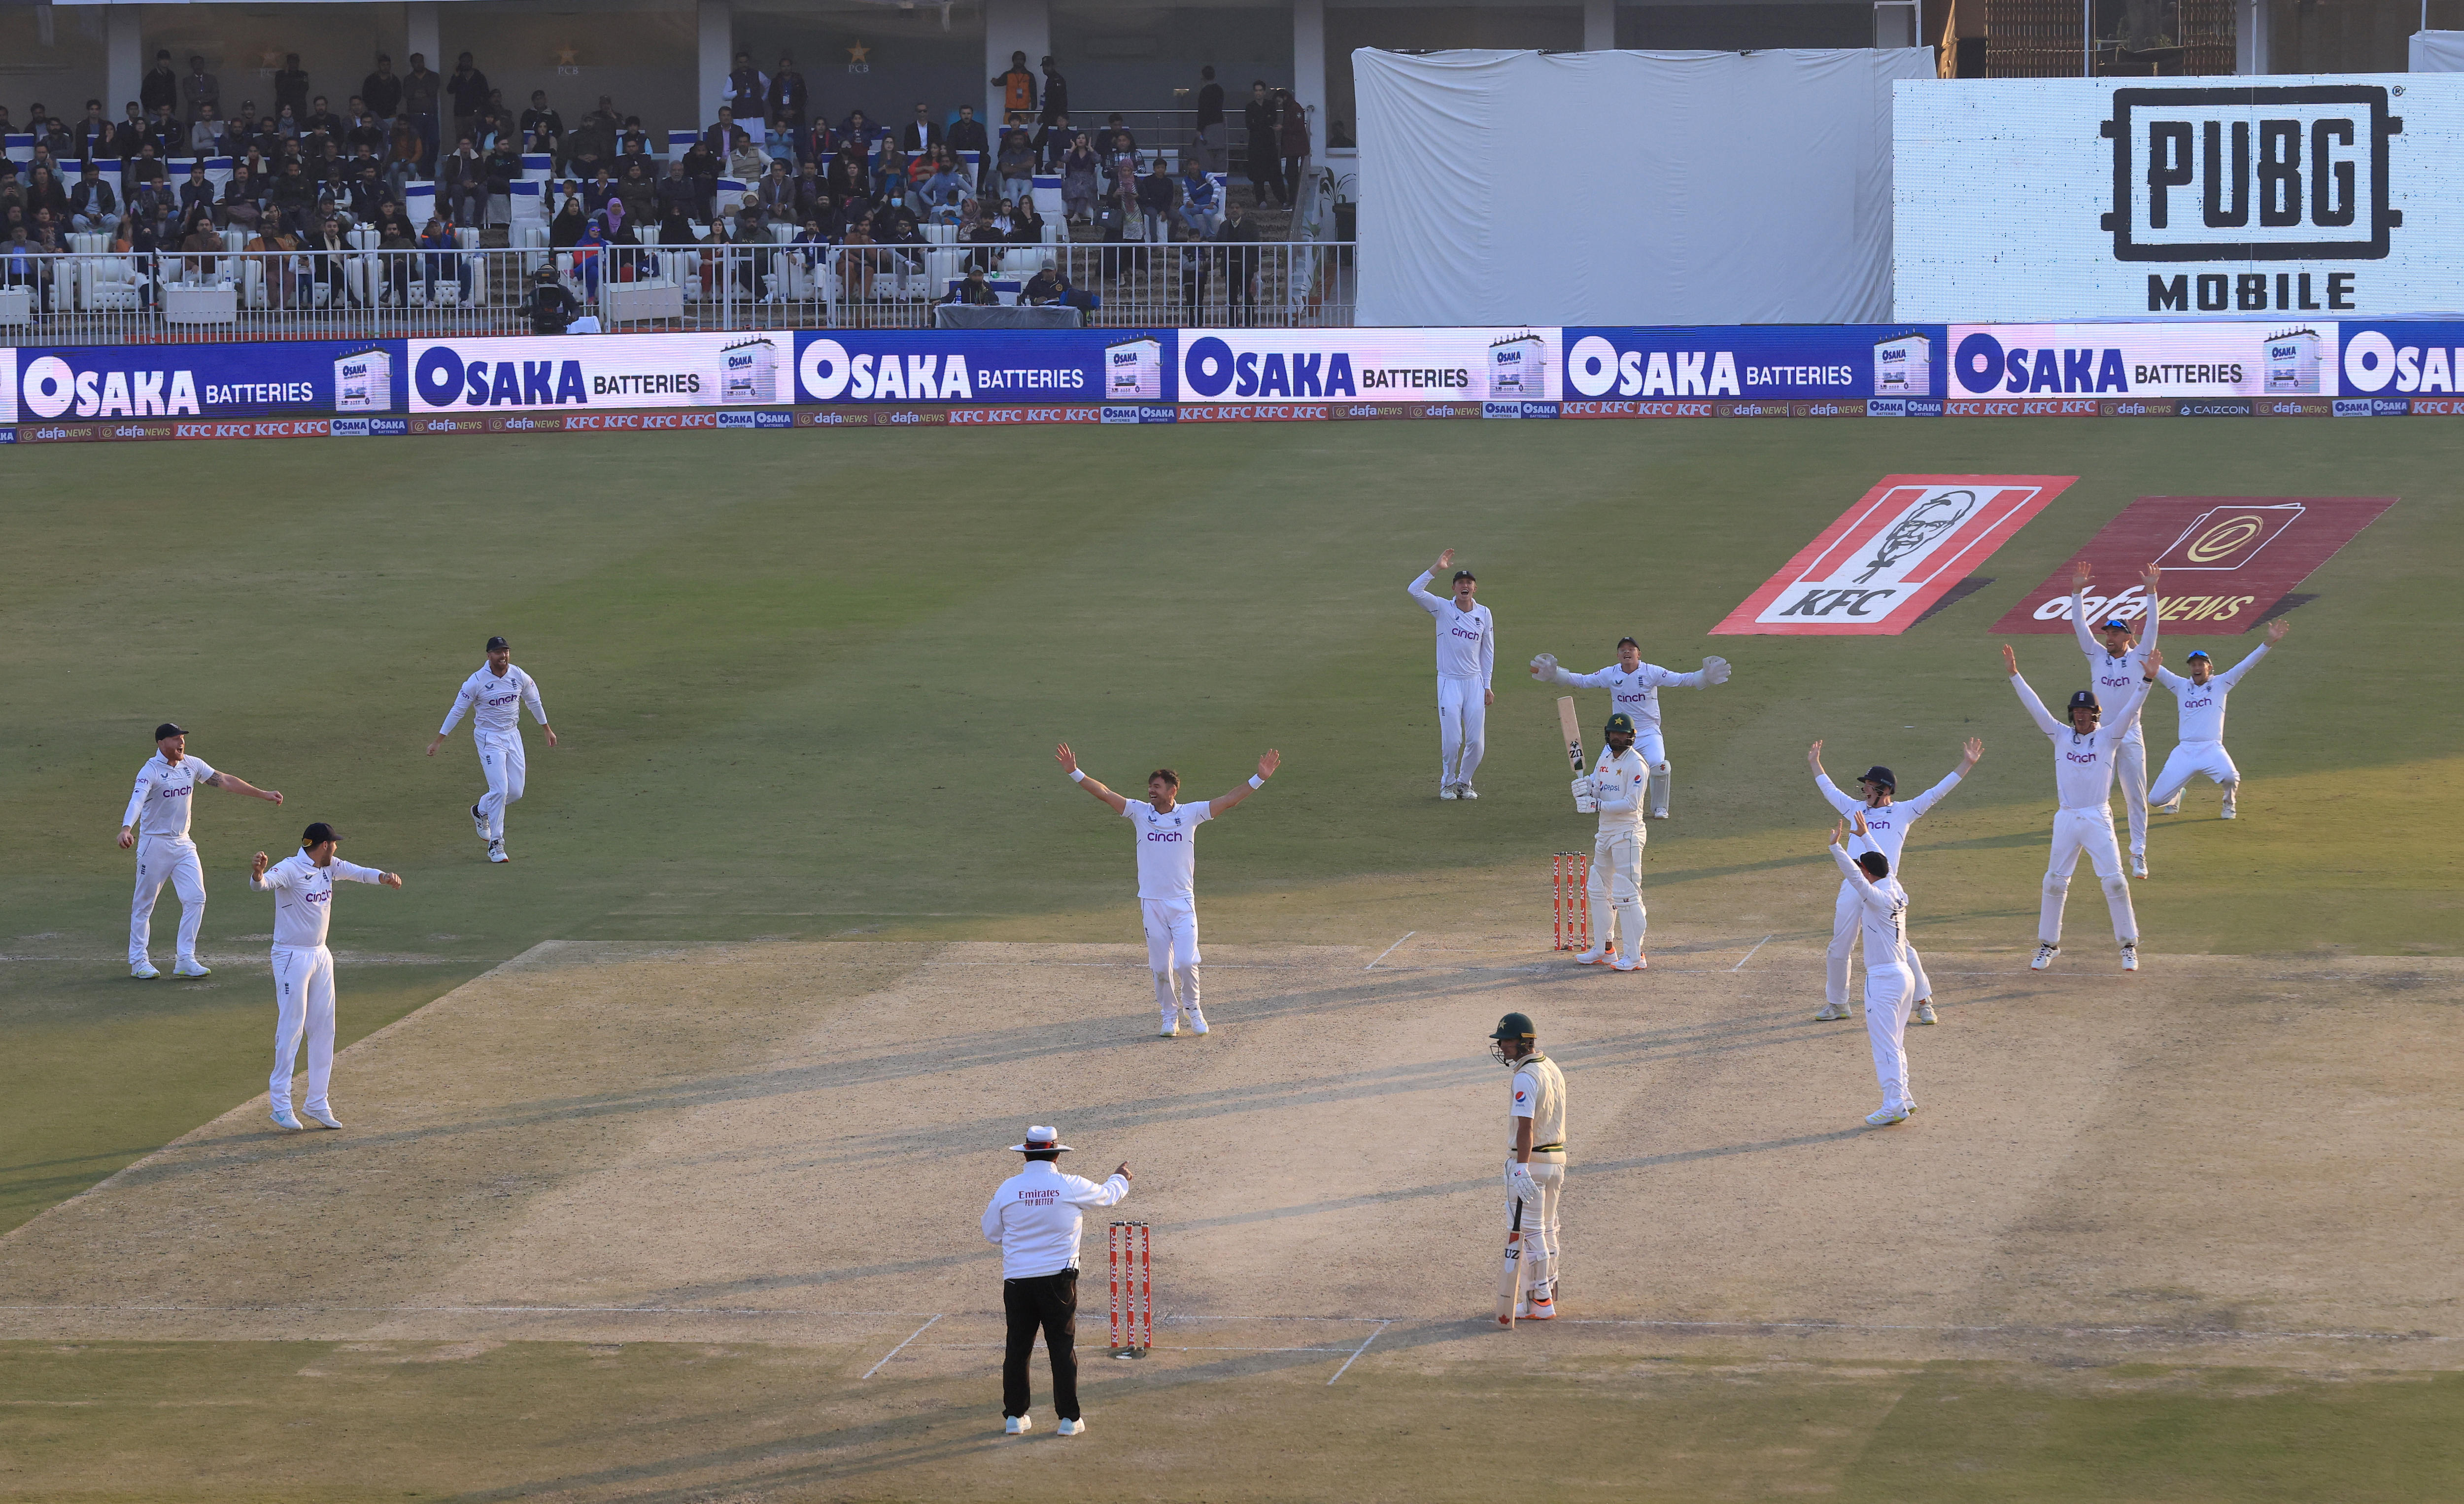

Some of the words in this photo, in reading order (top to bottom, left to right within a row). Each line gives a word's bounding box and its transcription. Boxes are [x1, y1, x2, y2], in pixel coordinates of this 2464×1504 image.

[558, 67, 579, 75] PCB
[849, 64, 869, 73] PCB
[2149, 118, 2355, 229] PUBG
[2148, 272, 2355, 311] MOBILE
[1113, 352, 1138, 365] OSAKA
[1497, 350, 1522, 364] OSAKA
[1882, 349, 1907, 362] OSAKA
[2272, 346, 2296, 358] OSAKA
[728, 354, 753, 368] OSAKA
[1185, 337, 1357, 397] OSAKA
[1363, 368, 1468, 388] BATTERIES
[1568, 336, 1741, 396] OSAKA
[1746, 365, 1852, 385] BATTERIES
[1954, 333, 2128, 393] OSAKA
[2135, 364, 2243, 384] BATTERIES
[342, 364, 367, 376] OSAKA
[799, 338, 973, 400] OSAKA
[978, 369, 1084, 389] BATTERIES
[415, 346, 587, 407] OSAKA
[594, 374, 700, 395] BATTERIES
[24, 355, 200, 418] OSAKA
[206, 382, 313, 404] BATTERIES
[1349, 405, 1402, 418] dafaNEWS
[1426, 405, 1480, 418] dafaNEWS
[1485, 403, 1519, 413] OSAKA
[1523, 403, 1556, 414] OSAKA
[1562, 402, 1596, 414] KFC
[1600, 402, 1635, 413] KFC
[1638, 403, 1673, 415] KFC
[1676, 404, 1711, 416] KFC
[1734, 404, 1787, 417] dafaNEWS
[1810, 403, 1864, 416] dafaNEWS
[1870, 401, 1903, 412] OSAKA
[1907, 401, 1941, 412] OSAKA
[1945, 403, 1980, 415] KFC
[1984, 403, 2018, 415] KFC
[2022, 402, 2057, 414] KFC
[2061, 401, 2095, 413] KFC
[2118, 403, 2171, 416] dafaNEWS
[2194, 406, 2249, 414] CAIZCOIN
[2273, 402, 2328, 415] dafaNEWS
[2335, 402, 2369, 412] OSAKA
[2373, 400, 2407, 411] OSAKA
[2412, 402, 2448, 414] KFC
[719, 414, 753, 424] OSAKA
[757, 413, 790, 423] OSAKA
[815, 412, 868, 425] dafaNEWS
[891, 412, 945, 424] dafaNEWS
[950, 411, 984, 423] KFC
[987, 410, 1022, 422] KFC
[1026, 409, 1061, 421] KFC
[1064, 409, 1099, 420] KFC
[1103, 408, 1137, 418] OSAKA
[1140, 407, 1174, 418] OSAKA
[1179, 408, 1214, 420] KFC
[1217, 407, 1251, 419] KFC
[1254, 406, 1288, 418] KFC
[1292, 407, 1327, 419] KFC
[333, 420, 367, 431] OSAKA
[371, 419, 405, 430] OSAKA
[428, 419, 482, 432] dafaNEWS
[506, 417, 560, 430] dafaNEWS
[565, 417, 600, 429] KFC
[603, 415, 638, 428] KFC
[642, 415, 677, 428] KFC
[680, 414, 716, 426] KFC
[37, 427, 91, 440] dafaNEWS
[116, 425, 171, 438] dafaNEWS
[176, 425, 211, 436] KFC
[215, 425, 251, 436] KFC
[254, 423, 289, 436] KFC
[293, 421, 327, 434] KFC
[1779, 589, 1896, 616] KFC
[1452, 627, 1479, 641] cinch
[2101, 674, 2130, 687] cinch
[489, 694, 517, 706] cinch
[1617, 692, 1646, 702] cinch
[1569, 749, 1583, 758] UZ
[2066, 752, 2096, 763] cinch
[163, 785, 192, 798] cinch
[1147, 830, 1182, 842] cinch
[306, 889, 332, 902] cinch
[1019, 1189, 1060, 1199] Emirates
[1505, 1249, 1520, 1259] UZ
